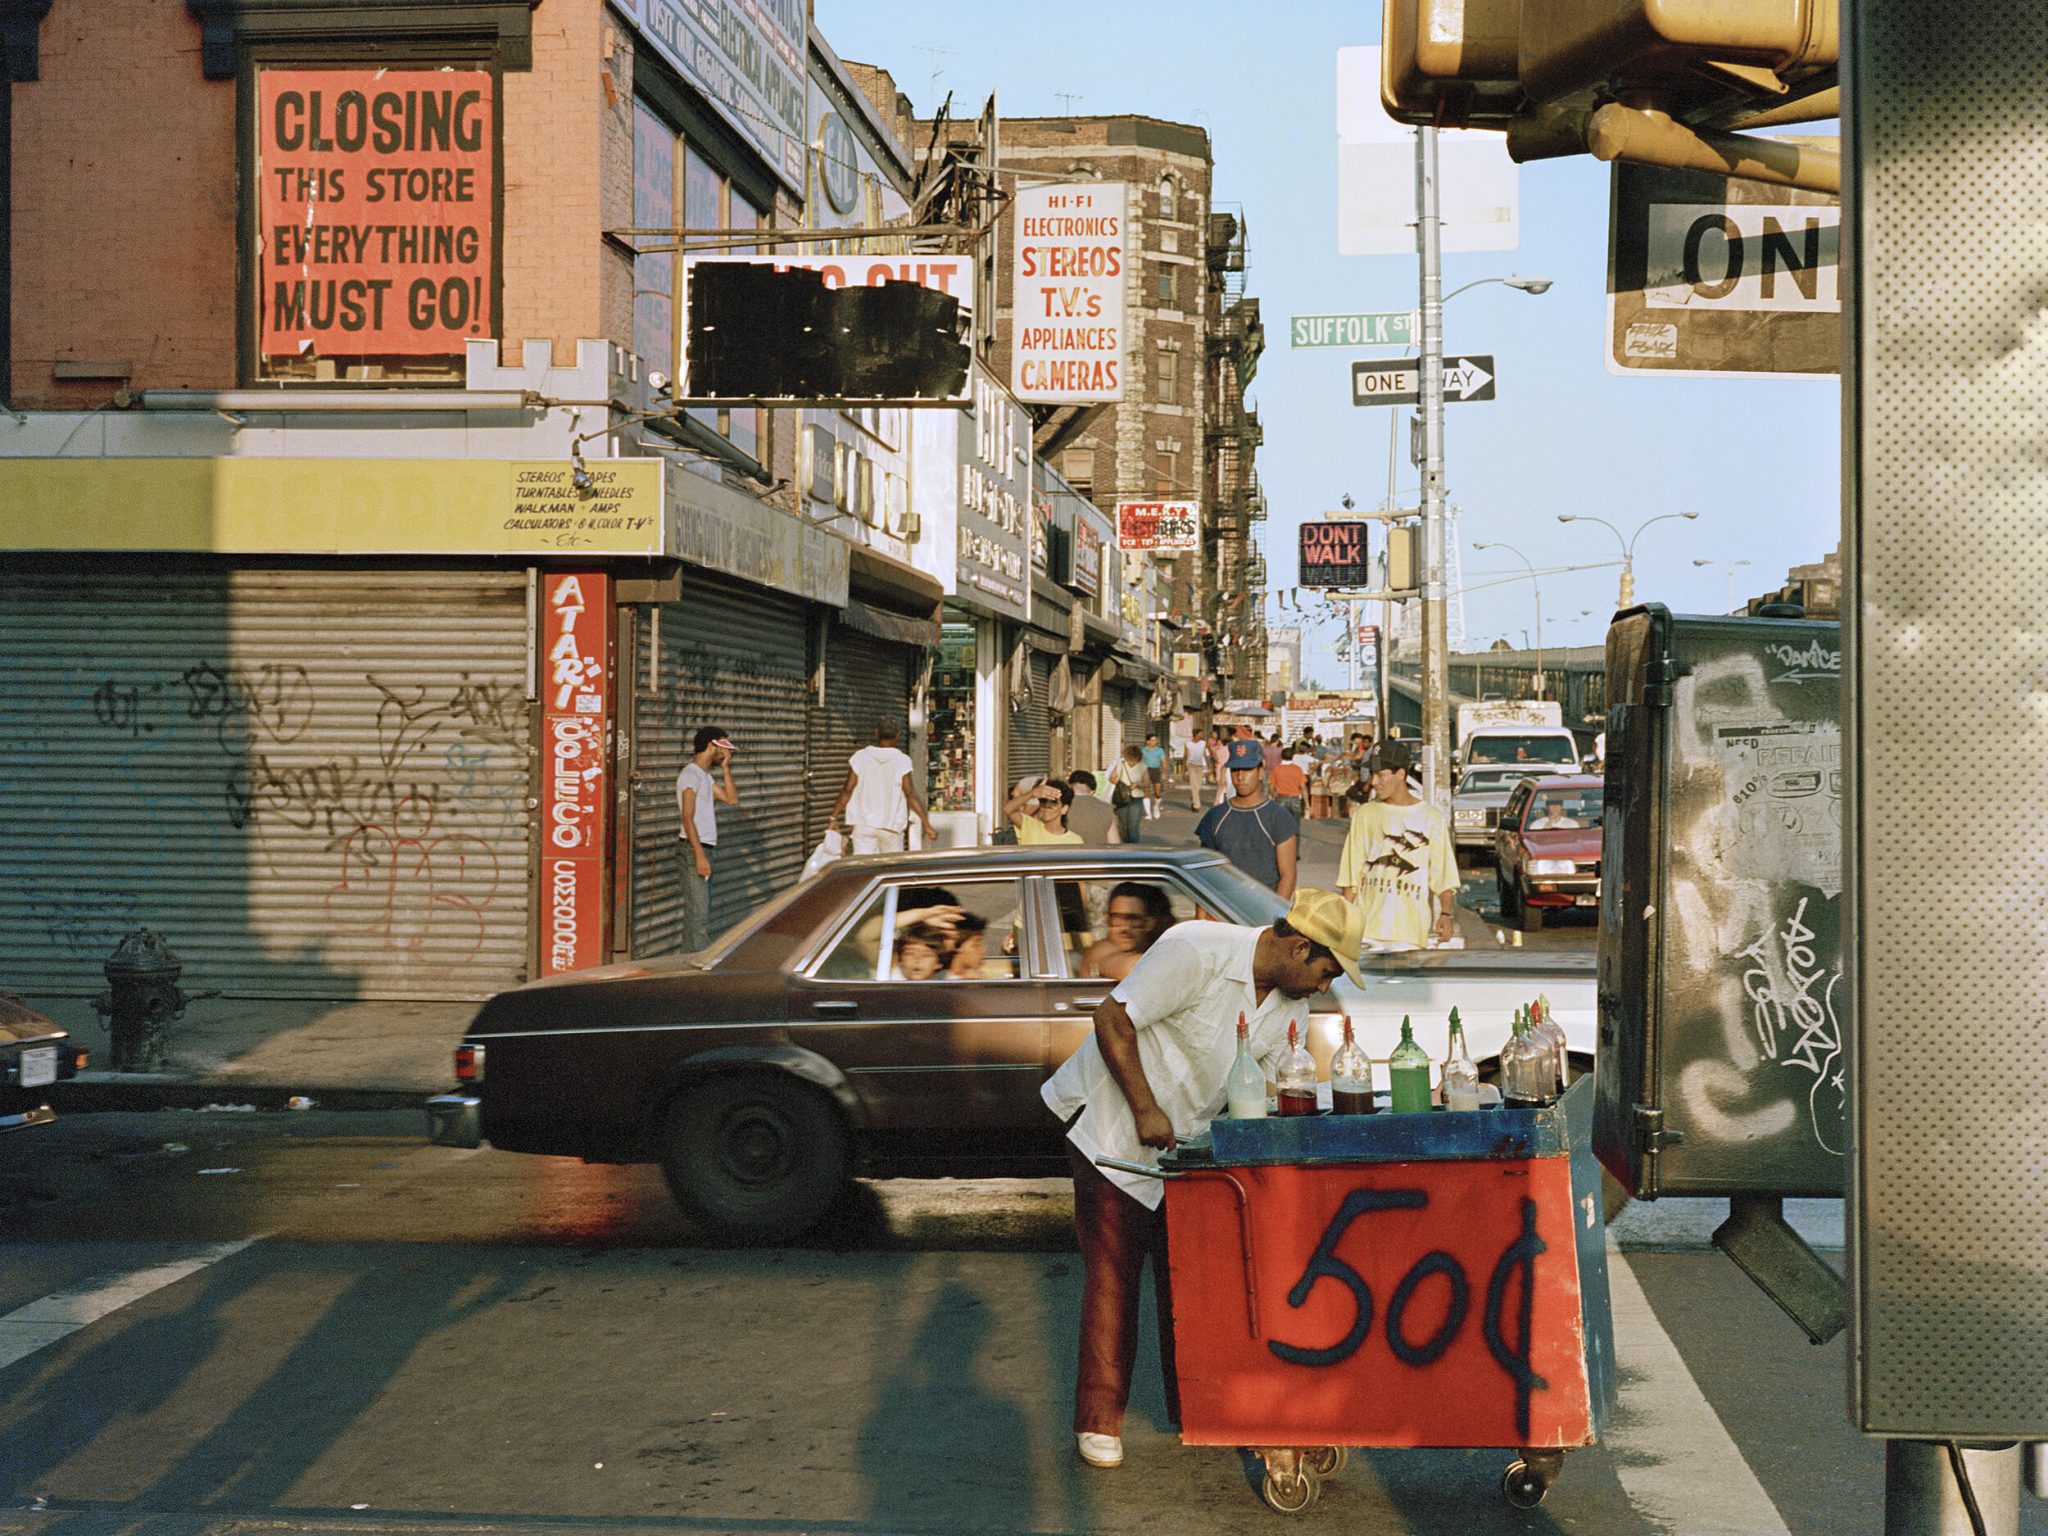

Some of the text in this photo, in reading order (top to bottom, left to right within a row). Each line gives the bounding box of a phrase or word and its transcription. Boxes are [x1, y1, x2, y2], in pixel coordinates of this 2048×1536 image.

[274, 90, 482, 154] CLOSING
[273, 167, 475, 203] THIS STORE
[1023, 216, 1119, 237] ELECTRONICS
[273, 225, 479, 266] EVERYTHING
[1683, 213, 1841, 301] ON
[1022, 246, 1122, 277] STEREOS
[273, 277, 482, 334] MUST GO!
[1021, 327, 1117, 350] APPLIANCES
[1295, 315, 1411, 346] SUFFOLK ST
[1021, 359, 1118, 391] CAMERAS
[1364, 370, 1474, 392] ONE AY
[516, 471, 617, 483] STEREOS APES
[516, 486, 635, 499] TURNTABLES NEEDLES
[503, 518, 573, 530] CALCULATORS
[514, 503, 621, 514] WALKMAN AMPS
[1303, 525, 1363, 545] DONT
[1304, 544, 1361, 565] WALK
[549, 575, 585, 710] ATARI
[552, 721, 582, 849] COLECO
[1268, 1187, 1550, 1441] 50¢
